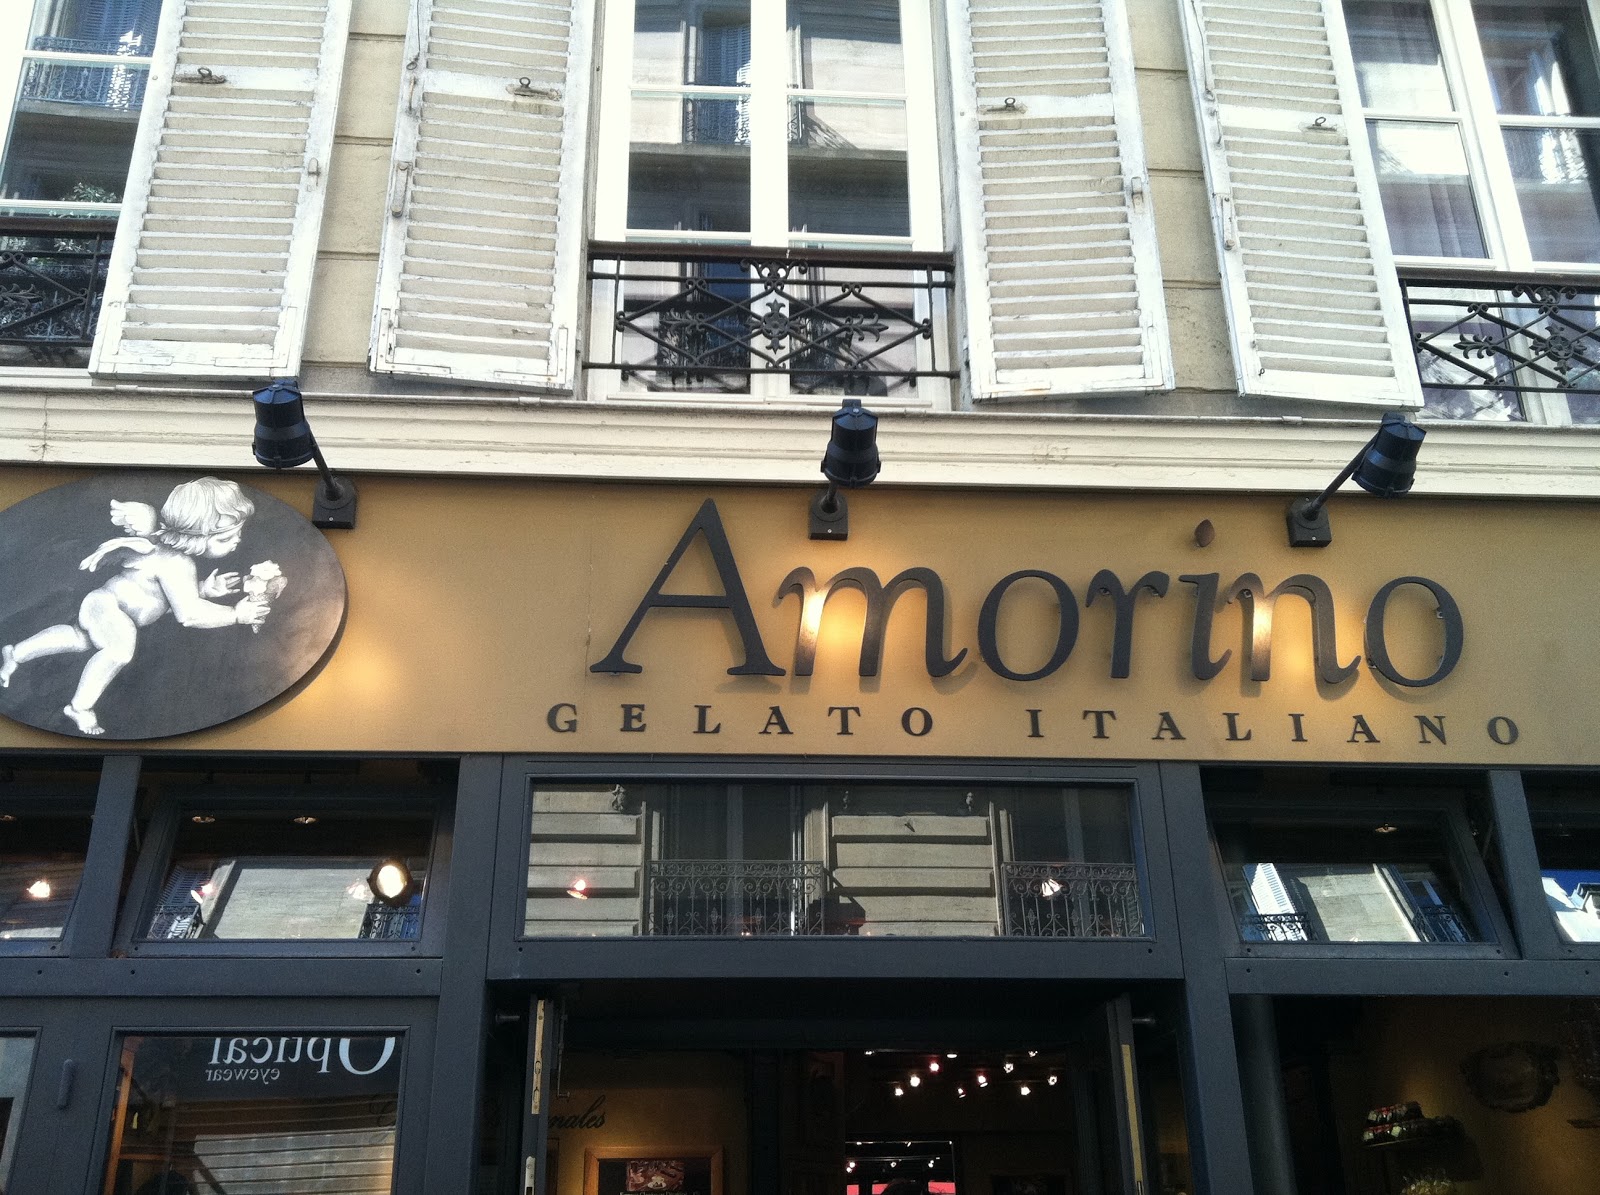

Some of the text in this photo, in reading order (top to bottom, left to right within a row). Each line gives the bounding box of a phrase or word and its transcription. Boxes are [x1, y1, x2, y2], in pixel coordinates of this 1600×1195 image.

[590, 498, 1464, 688] Amorino
[546, 702, 1520, 746] GELATO ITALIANO
